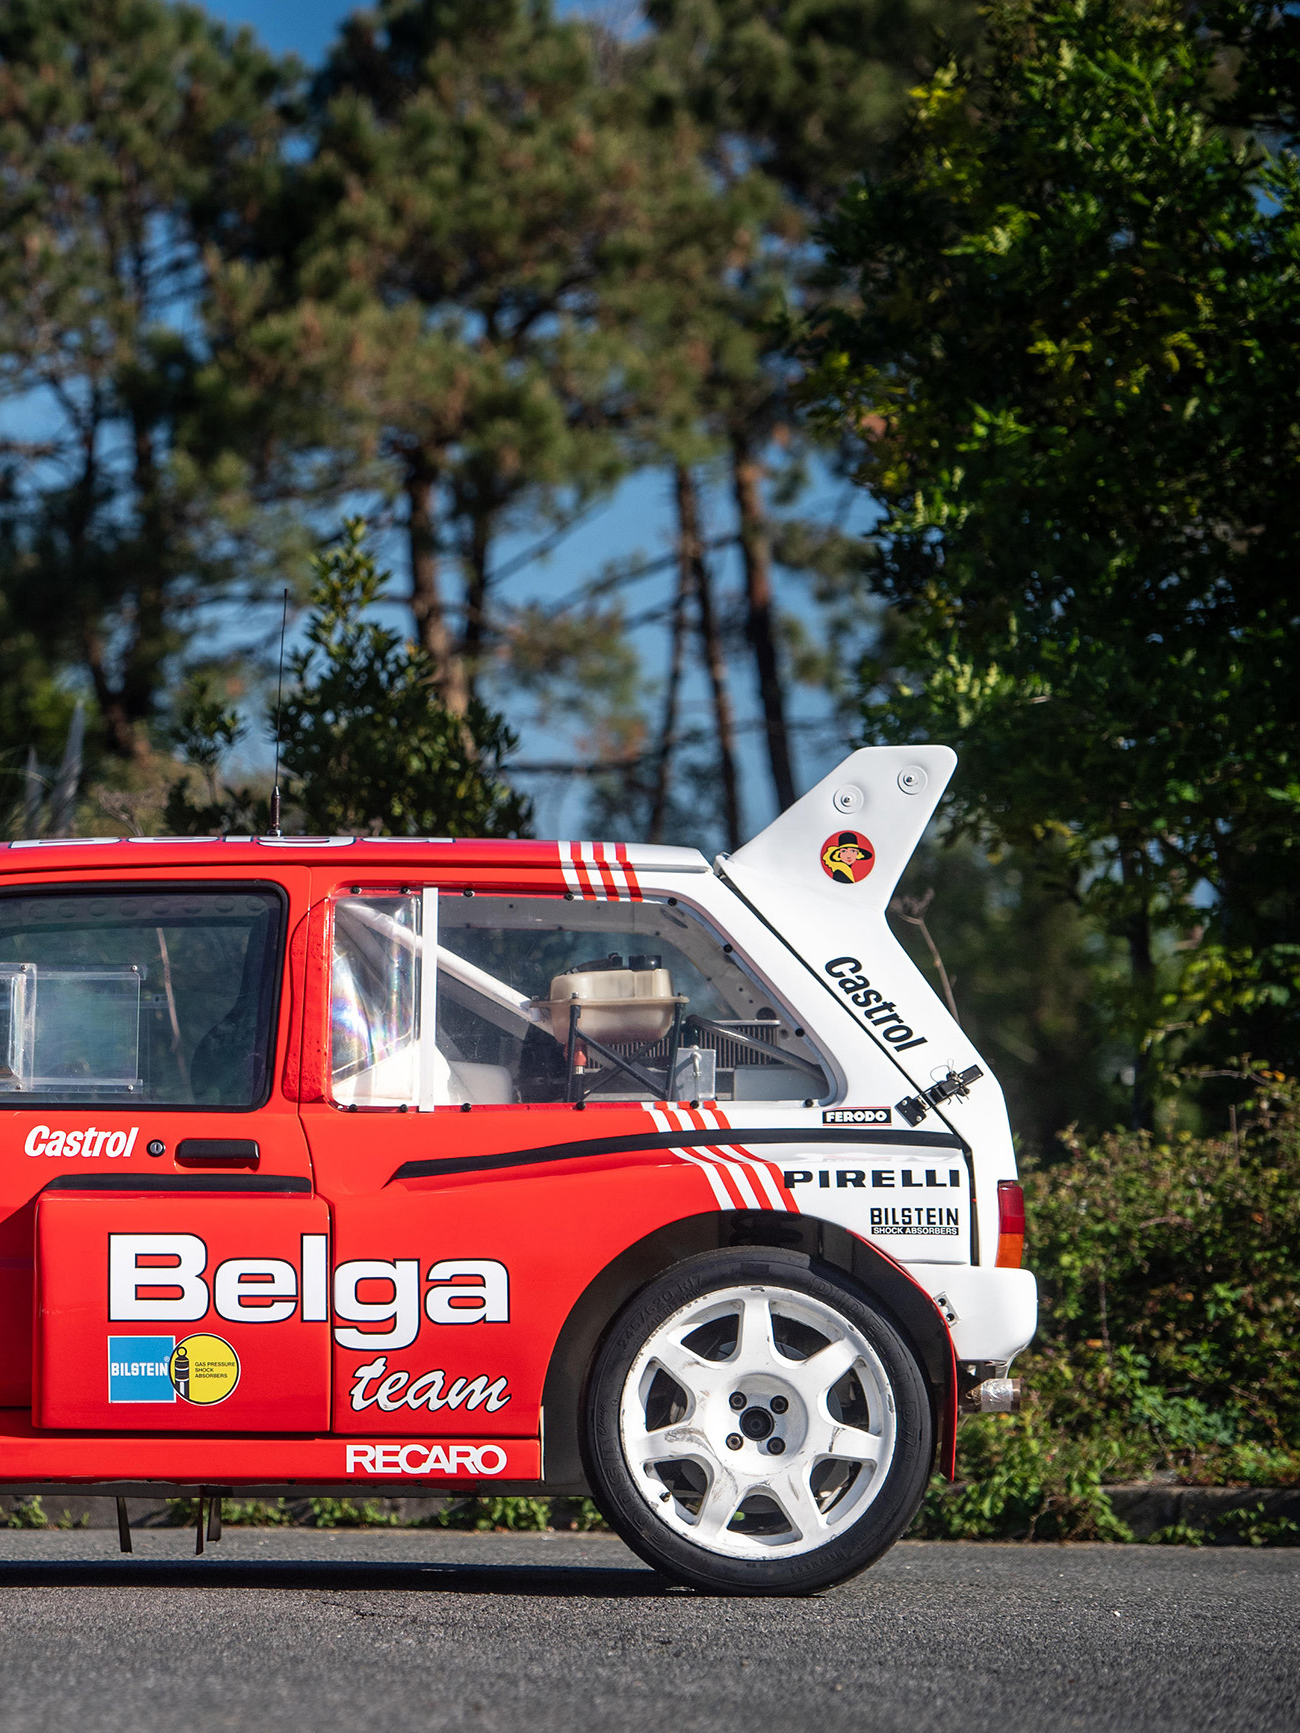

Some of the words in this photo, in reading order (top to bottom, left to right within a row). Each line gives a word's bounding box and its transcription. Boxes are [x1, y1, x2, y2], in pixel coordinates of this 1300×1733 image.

[824, 956, 928, 1053] Castrol
[826, 1111, 887, 1123] FERODO
[24, 1125, 139, 1158] Castrol
[784, 1169, 960, 1188] PIRELLI
[870, 1207, 959, 1225] BILSTEIN
[873, 1227, 904, 1235] SHOCK
[905, 1227, 958, 1235] ABSORBERS
[108, 1232, 511, 1350] Belga
[111, 1362, 168, 1376] BILSTEIN
[350, 1356, 512, 1412] team
[346, 1444, 507, 1475] RECARO
